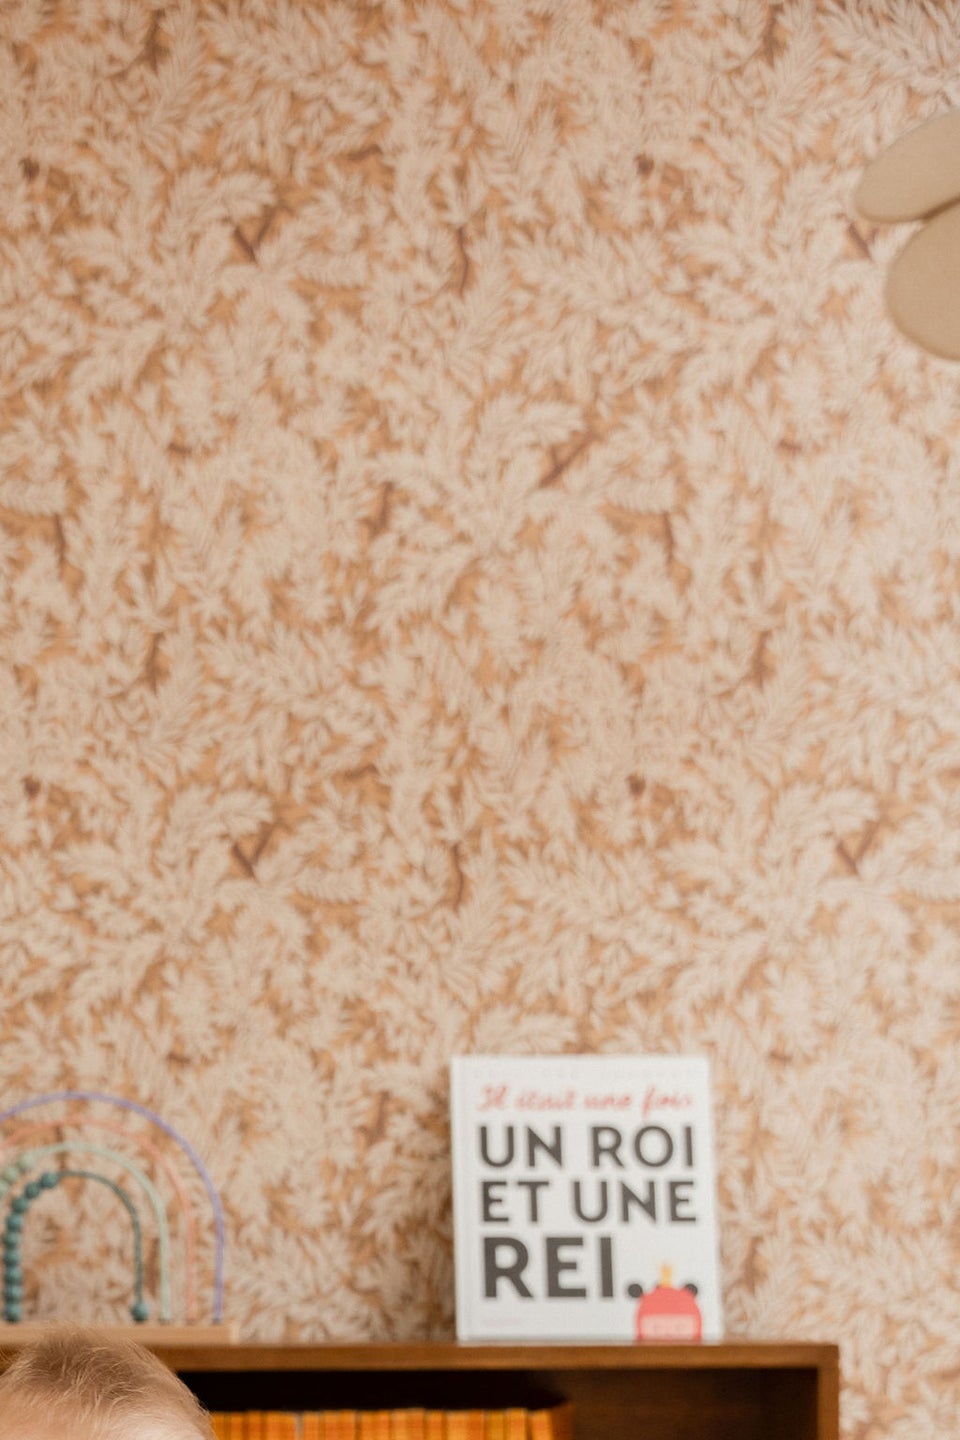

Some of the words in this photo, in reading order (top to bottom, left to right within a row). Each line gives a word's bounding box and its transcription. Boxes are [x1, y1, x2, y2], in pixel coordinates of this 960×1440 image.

[479, 1125, 563, 1168] UN
[591, 1125, 694, 1168] ROI
[481, 1180, 550, 1223] ET
[573, 1180, 697, 1223] UNE
